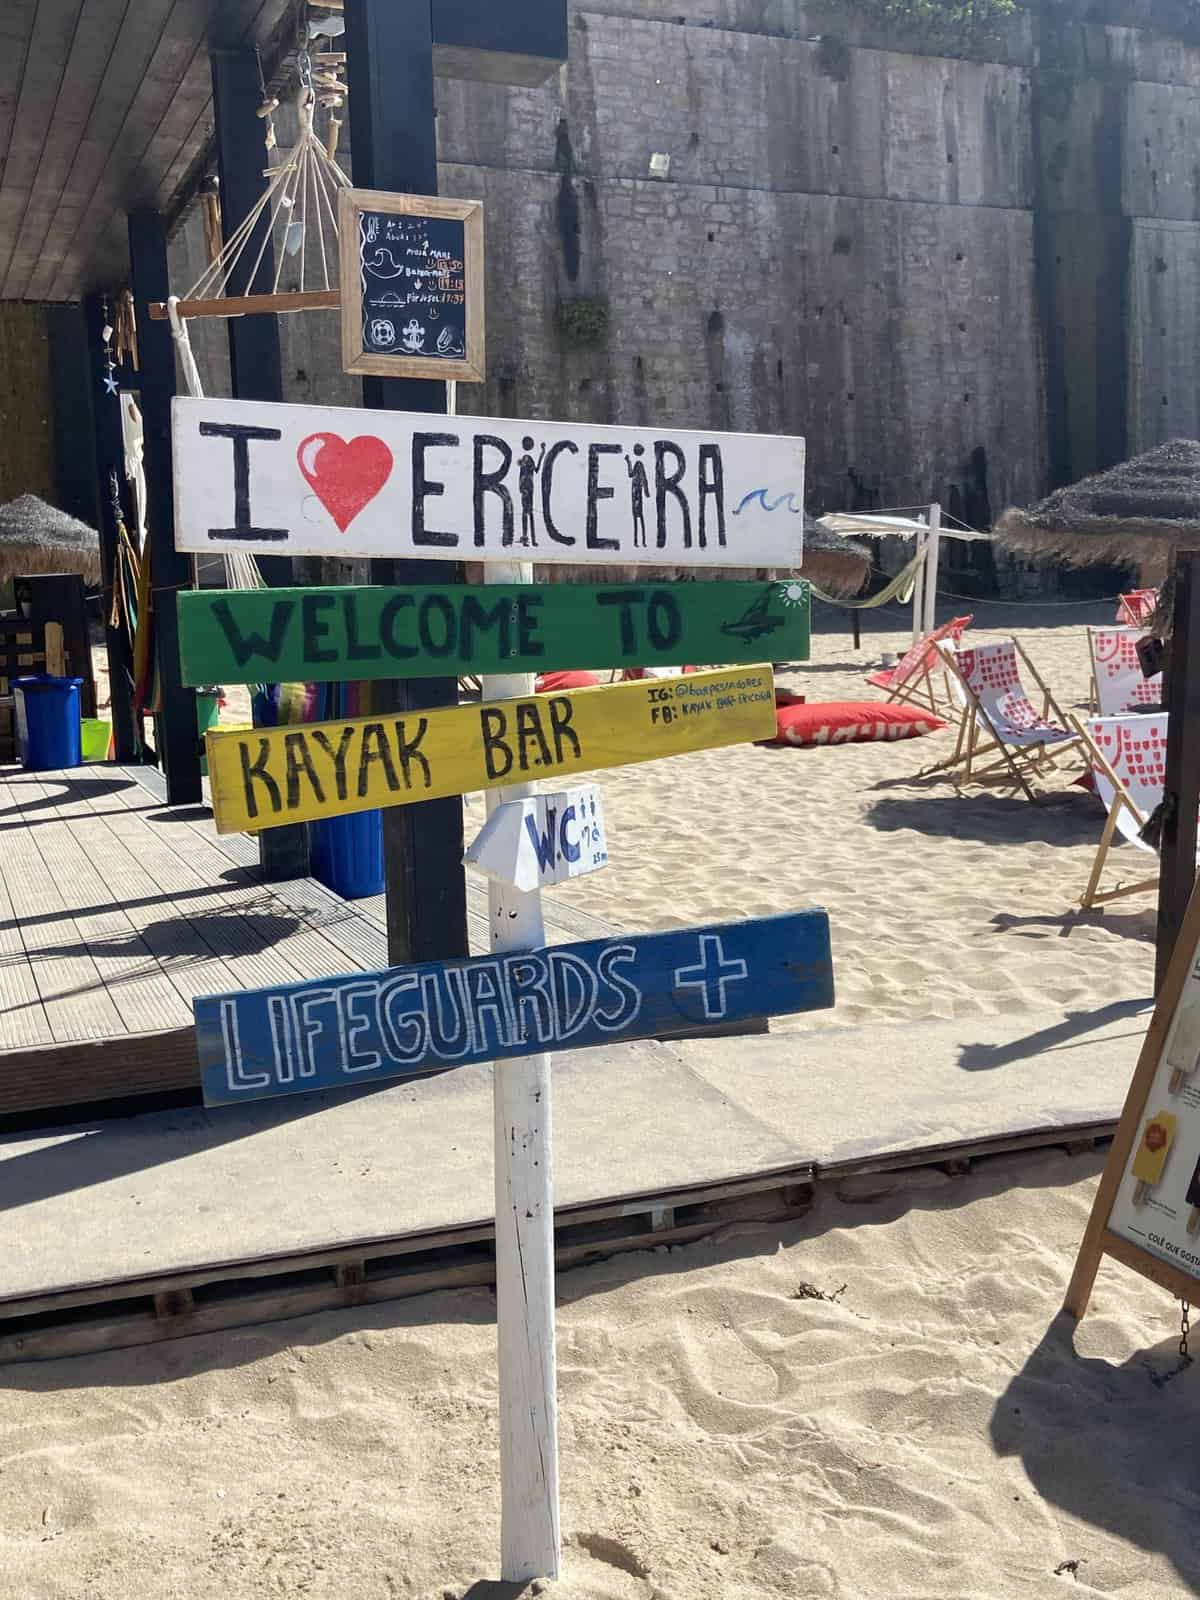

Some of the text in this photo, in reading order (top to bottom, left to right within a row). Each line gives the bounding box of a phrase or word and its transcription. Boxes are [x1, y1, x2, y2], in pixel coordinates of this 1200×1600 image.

[200, 421, 288, 541] I
[210, 590, 683, 667] WELCOME TO
[238, 696, 582, 819] KAYAK BAR
[220, 944, 643, 1090] LIFEGUARDS
